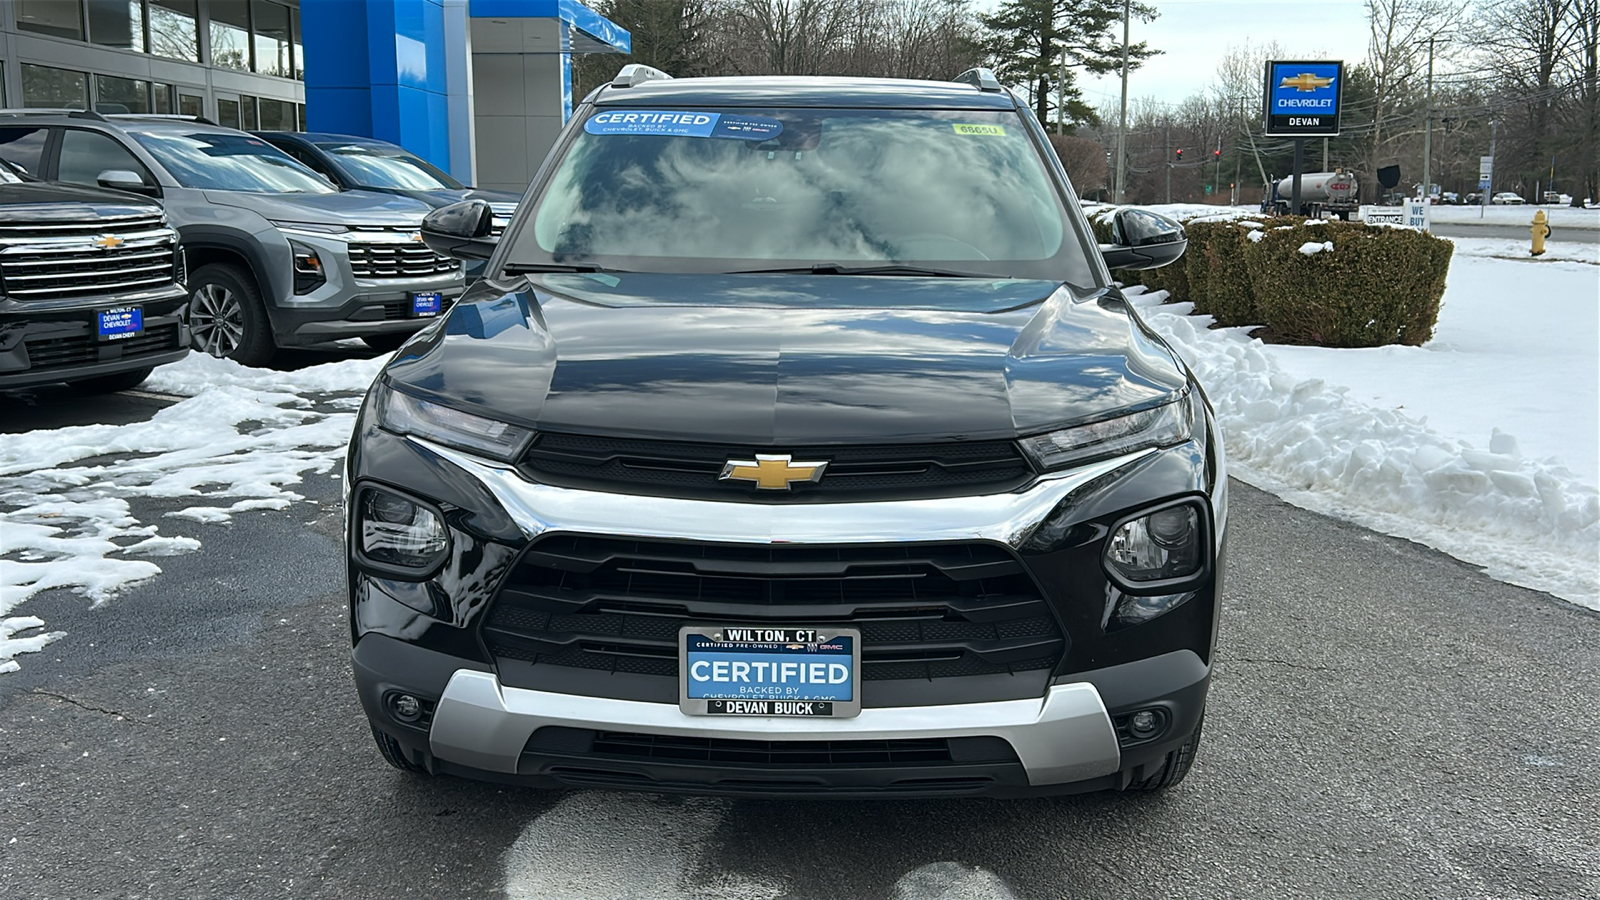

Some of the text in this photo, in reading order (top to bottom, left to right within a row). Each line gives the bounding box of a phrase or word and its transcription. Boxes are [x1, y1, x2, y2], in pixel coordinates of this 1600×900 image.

[1278, 98, 1333, 107] CHEVROLET
[594, 113, 710, 125] CERTIFIED
[1289, 117, 1320, 126] DEVAN
[1412, 206, 1424, 215] WE
[1369, 215, 1403, 224] ENTRANCE
[1410, 217, 1425, 226] BUY
[103, 314, 120, 322] DEVAN
[103, 319, 132, 329] CHEVROLET
[727, 629, 815, 643] WILTON, CT
[690, 660, 849, 685] CERTIFIED
[740, 686, 800, 695] BACKED BY
[726, 701, 814, 715] DEVAN BUICK
